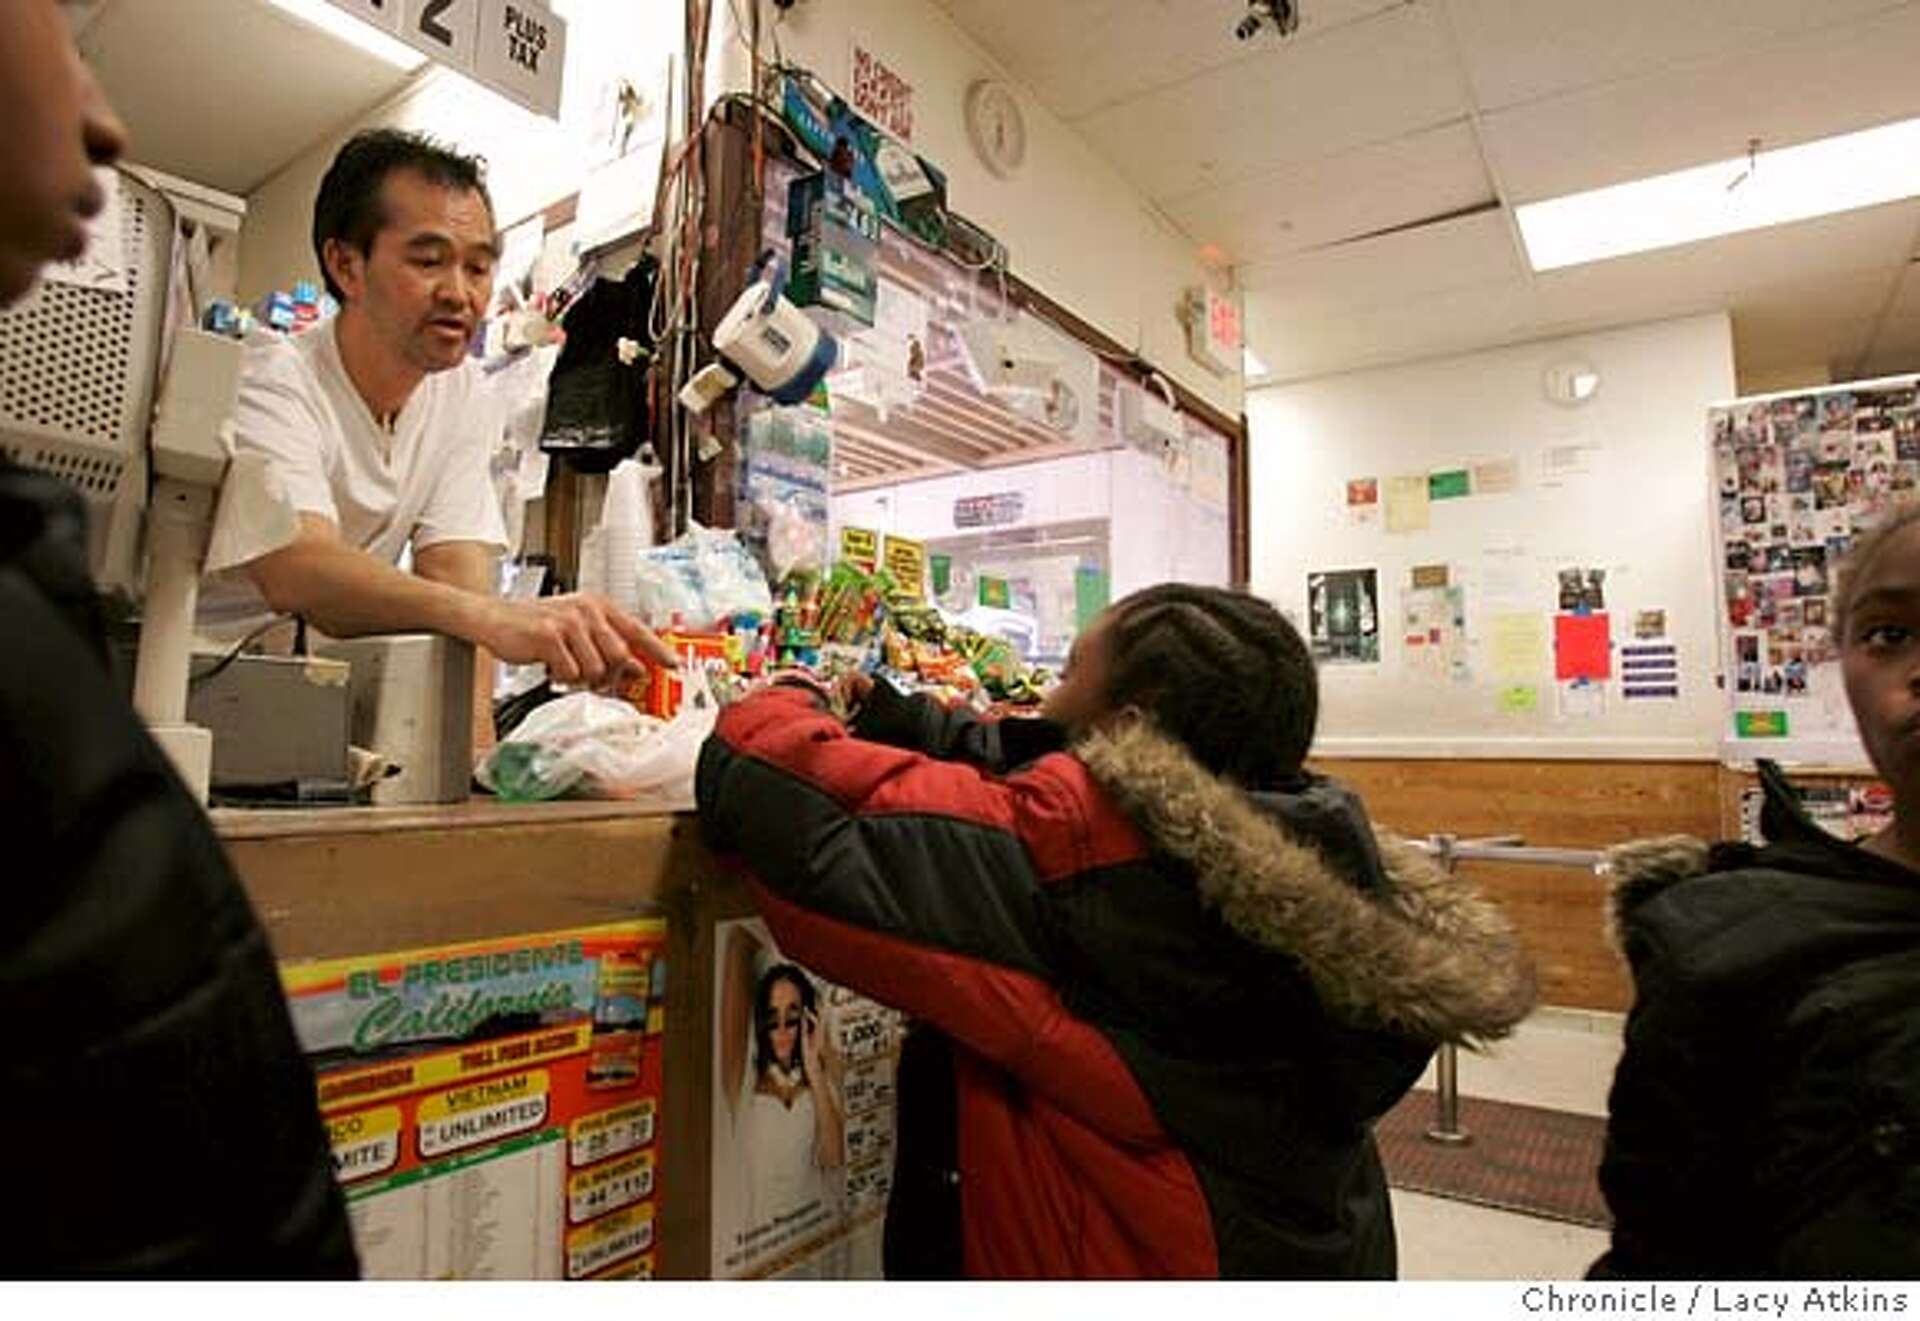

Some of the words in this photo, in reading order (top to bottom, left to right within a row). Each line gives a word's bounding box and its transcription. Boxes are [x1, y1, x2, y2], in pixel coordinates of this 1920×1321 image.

[504, 5, 547, 50] PLUS
[508, 34, 538, 74] TAX
[348, 968, 393, 998] EL
[402, 939, 584, 985] PRESIDENTE
[353, 982, 574, 1052] California
[446, 1075, 528, 1107] VIETNAM
[439, 1098, 544, 1142] UNLIMITED
